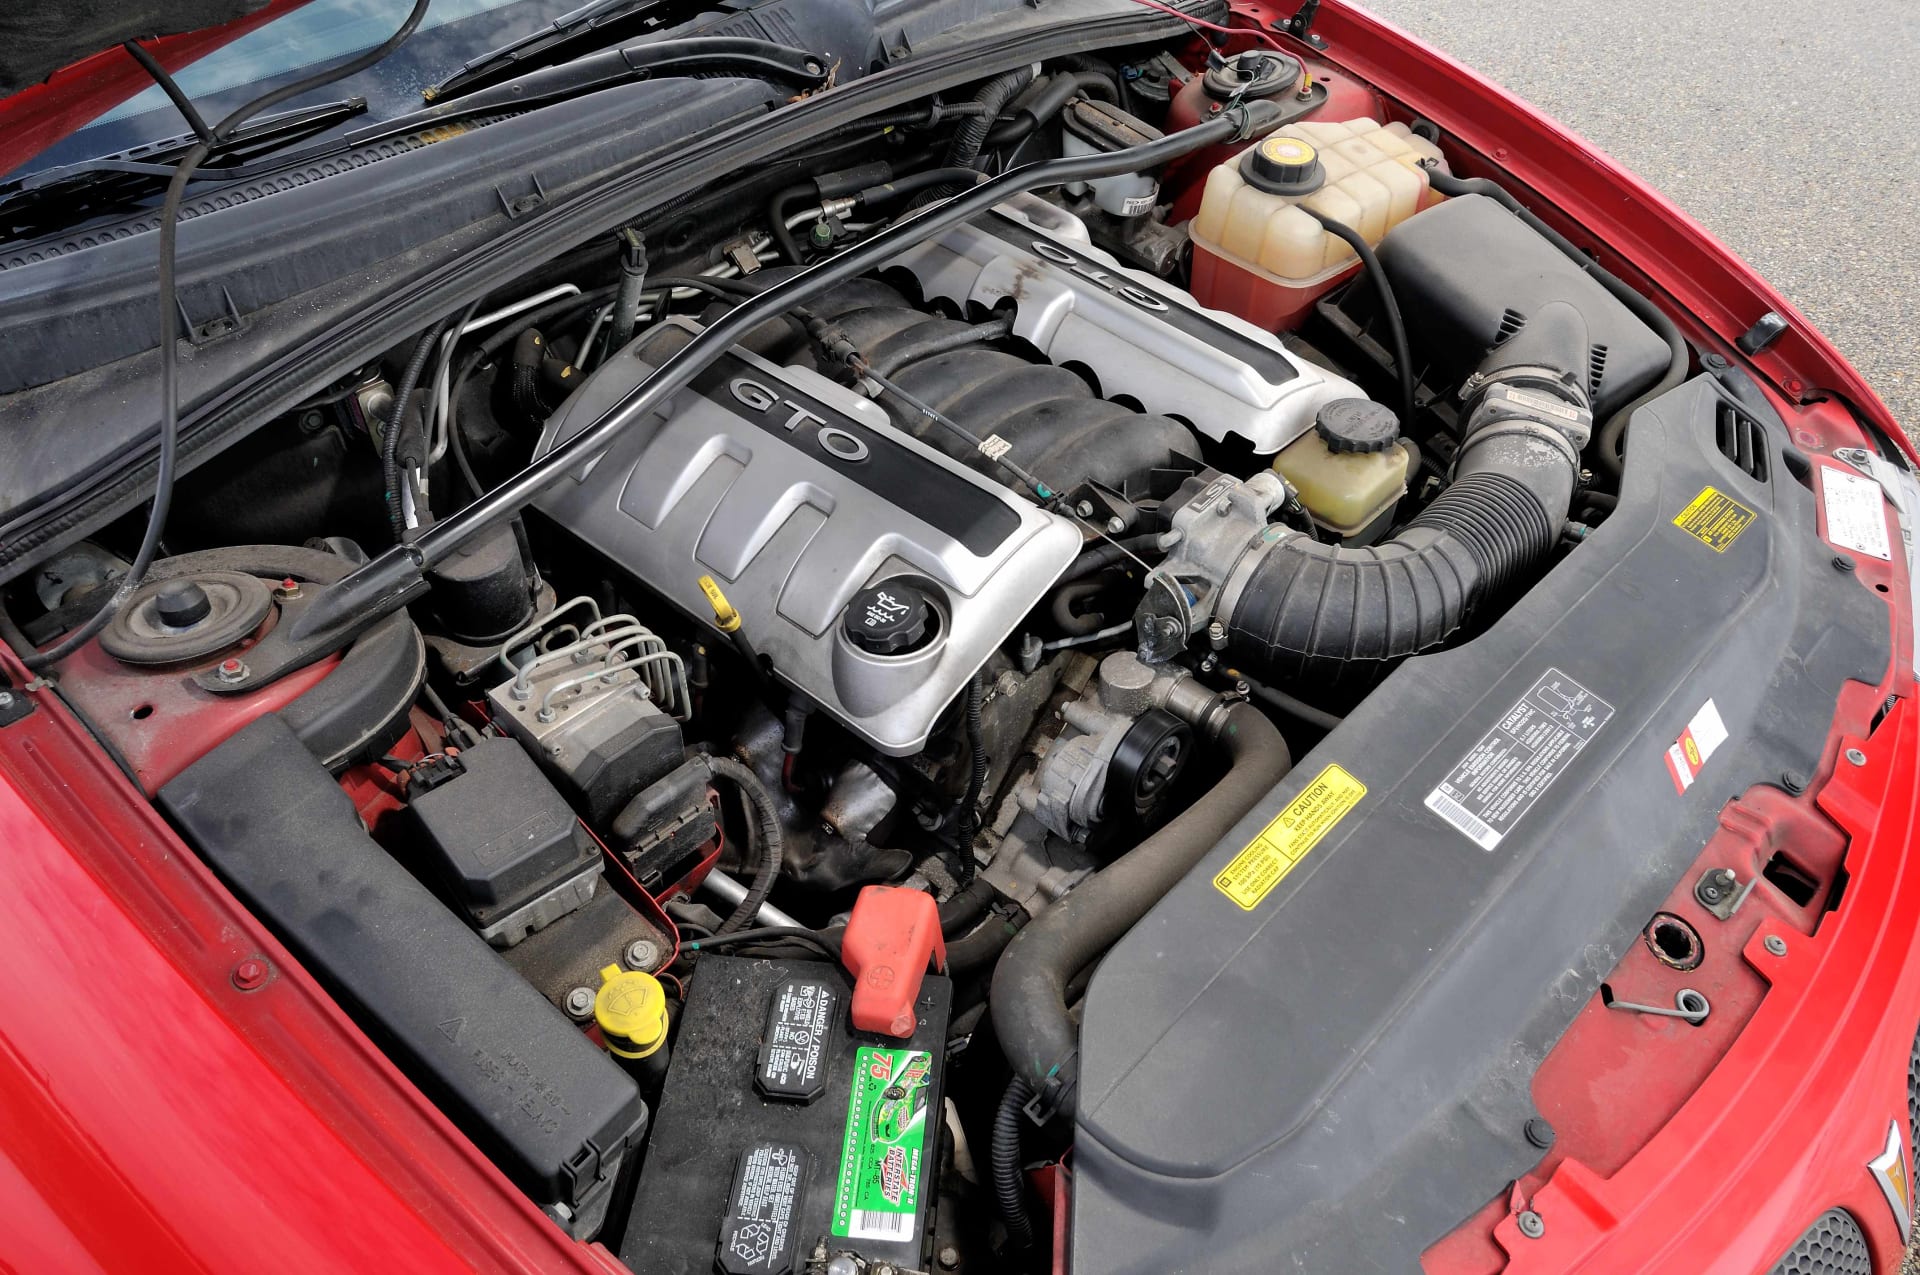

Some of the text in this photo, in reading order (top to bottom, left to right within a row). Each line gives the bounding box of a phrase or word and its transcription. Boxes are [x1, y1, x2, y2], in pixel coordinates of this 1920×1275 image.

[729, 378, 869, 461] GTO
[1191, 478, 1234, 511] LS1
[1500, 702, 1530, 730] CATALYST
[1454, 768, 1471, 784] VEHICLE
[1467, 751, 1486, 770] EMISSION
[1482, 736, 1501, 754] CONTROL
[1291, 781, 1328, 817] CAUTION
[1293, 818, 1307, 832] KEEP
[1304, 803, 1322, 820] HANDS
[1243, 841, 1263, 860] COOLING
[1247, 844, 1269, 865] PRESSURE
[1248, 875, 1262, 887] ONLY
[1259, 857, 1279, 876] CORRECT
[812, 999, 829, 1035] DANGER
[788, 1031, 795, 1040] NO
[804, 1044, 820, 1079] POISON
[869, 1051, 892, 1080] 75
[883, 1149, 895, 1196] BATTERIES
[890, 1148, 903, 1201] INTERSTATE
[907, 1148, 919, 1194] MEGA-TRON
